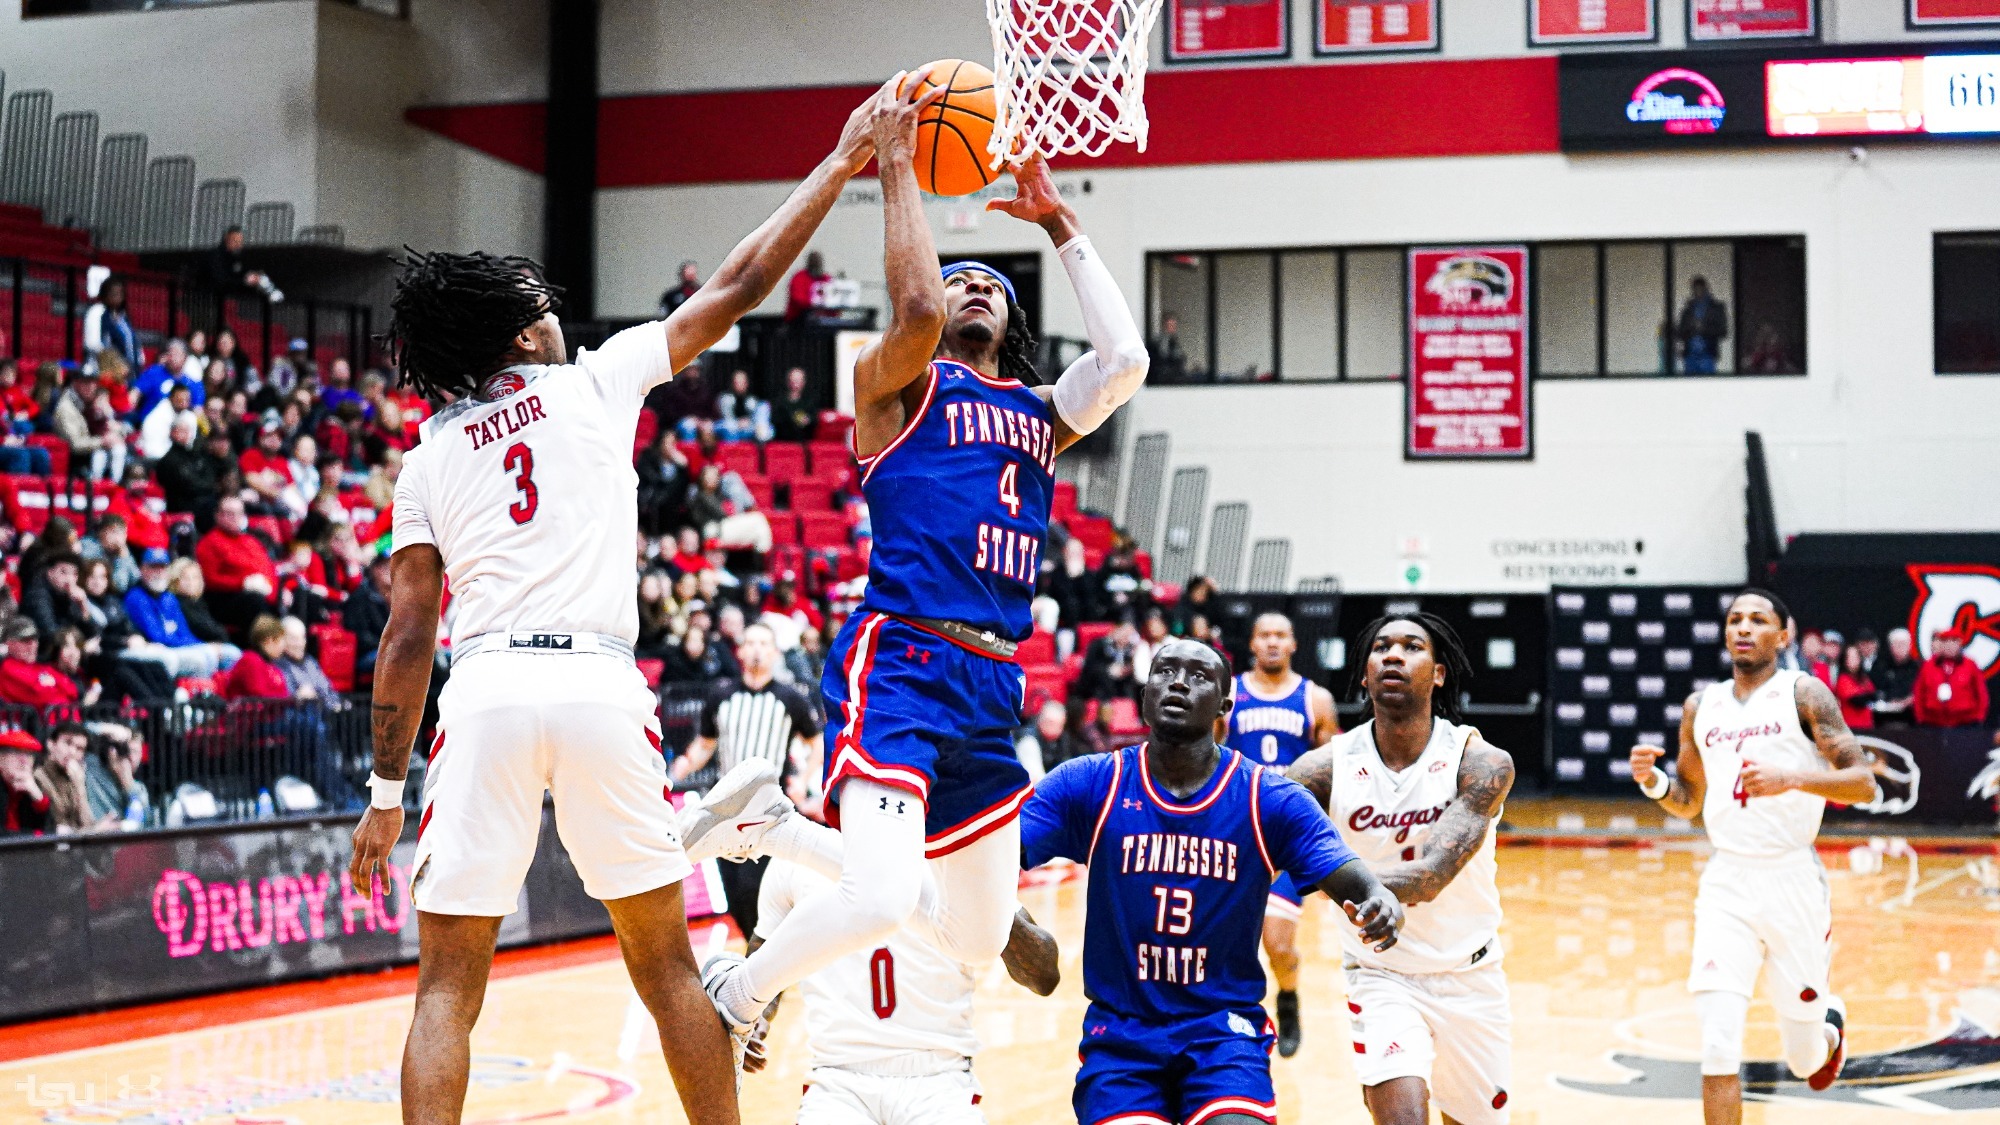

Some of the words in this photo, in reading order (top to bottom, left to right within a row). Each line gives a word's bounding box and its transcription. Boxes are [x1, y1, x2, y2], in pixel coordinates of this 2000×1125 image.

[1949, 71, 1995, 107] 66
[464, 395, 547, 451] TAYLOR
[503, 441, 539, 526] 3
[998, 461, 1022, 518] 4
[974, 522, 1039, 586] STATE
[1261, 734, 1278, 763] 0
[1705, 721, 1782, 753] Cougars
[1348, 800, 1452, 844] Cougar
[1121, 833, 1238, 883] TENNESSEE
[152, 868, 330, 958] DRURY
[1153, 885, 1195, 936] 13
[870, 946, 897, 1020] 0
[1137, 942, 1208, 985] STATE
